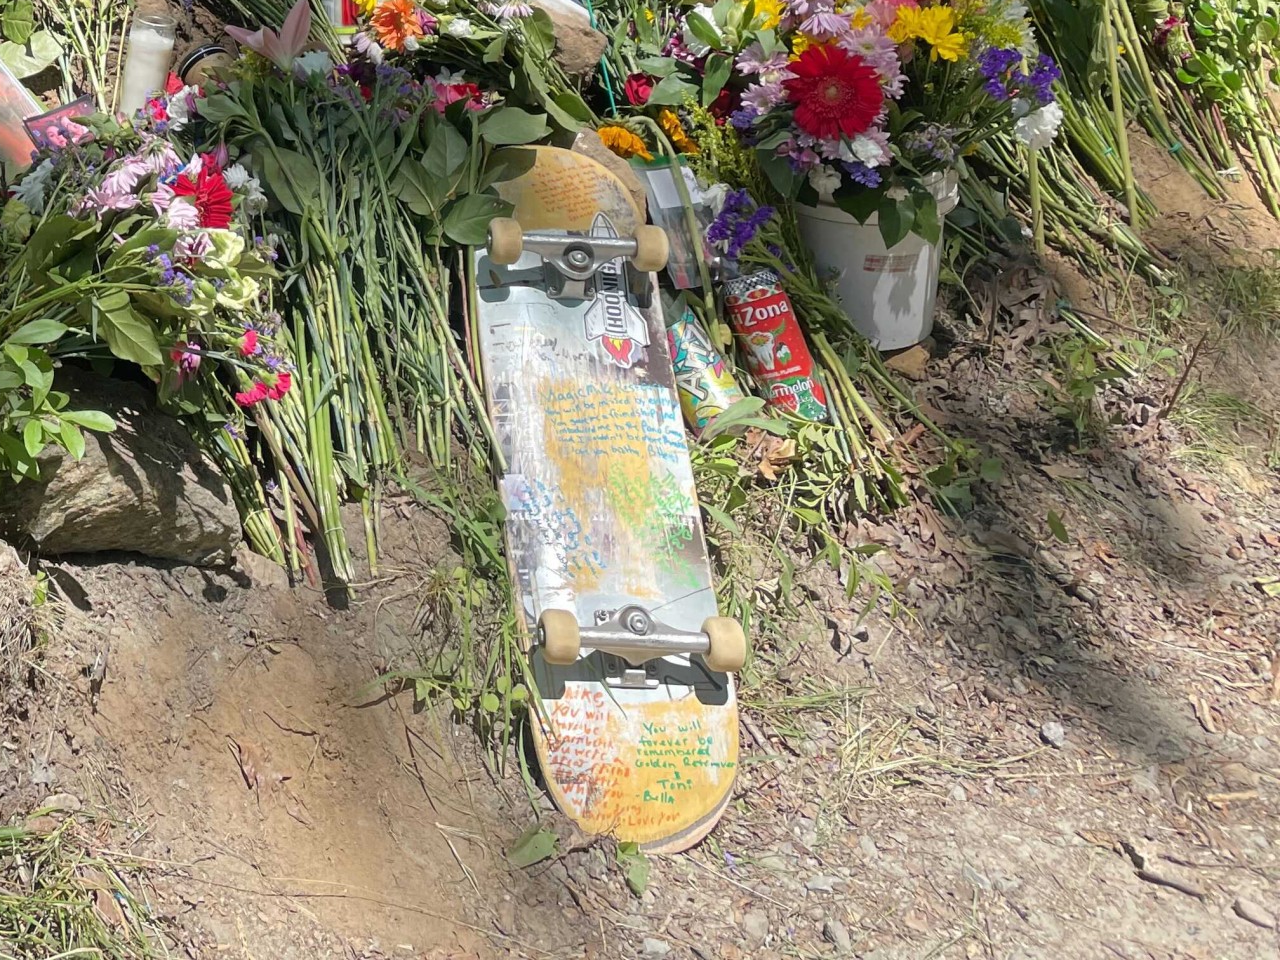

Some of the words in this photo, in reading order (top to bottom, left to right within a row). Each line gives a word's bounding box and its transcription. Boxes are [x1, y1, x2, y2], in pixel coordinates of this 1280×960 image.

[731, 300, 789, 327] riZona
[642, 722, 666, 735] You
[678, 719, 701, 732] will
[639, 735, 688, 746] forever
[697, 735, 713, 745] be
[635, 758, 677, 768] Golden
[656, 779, 692, 790] Toni
